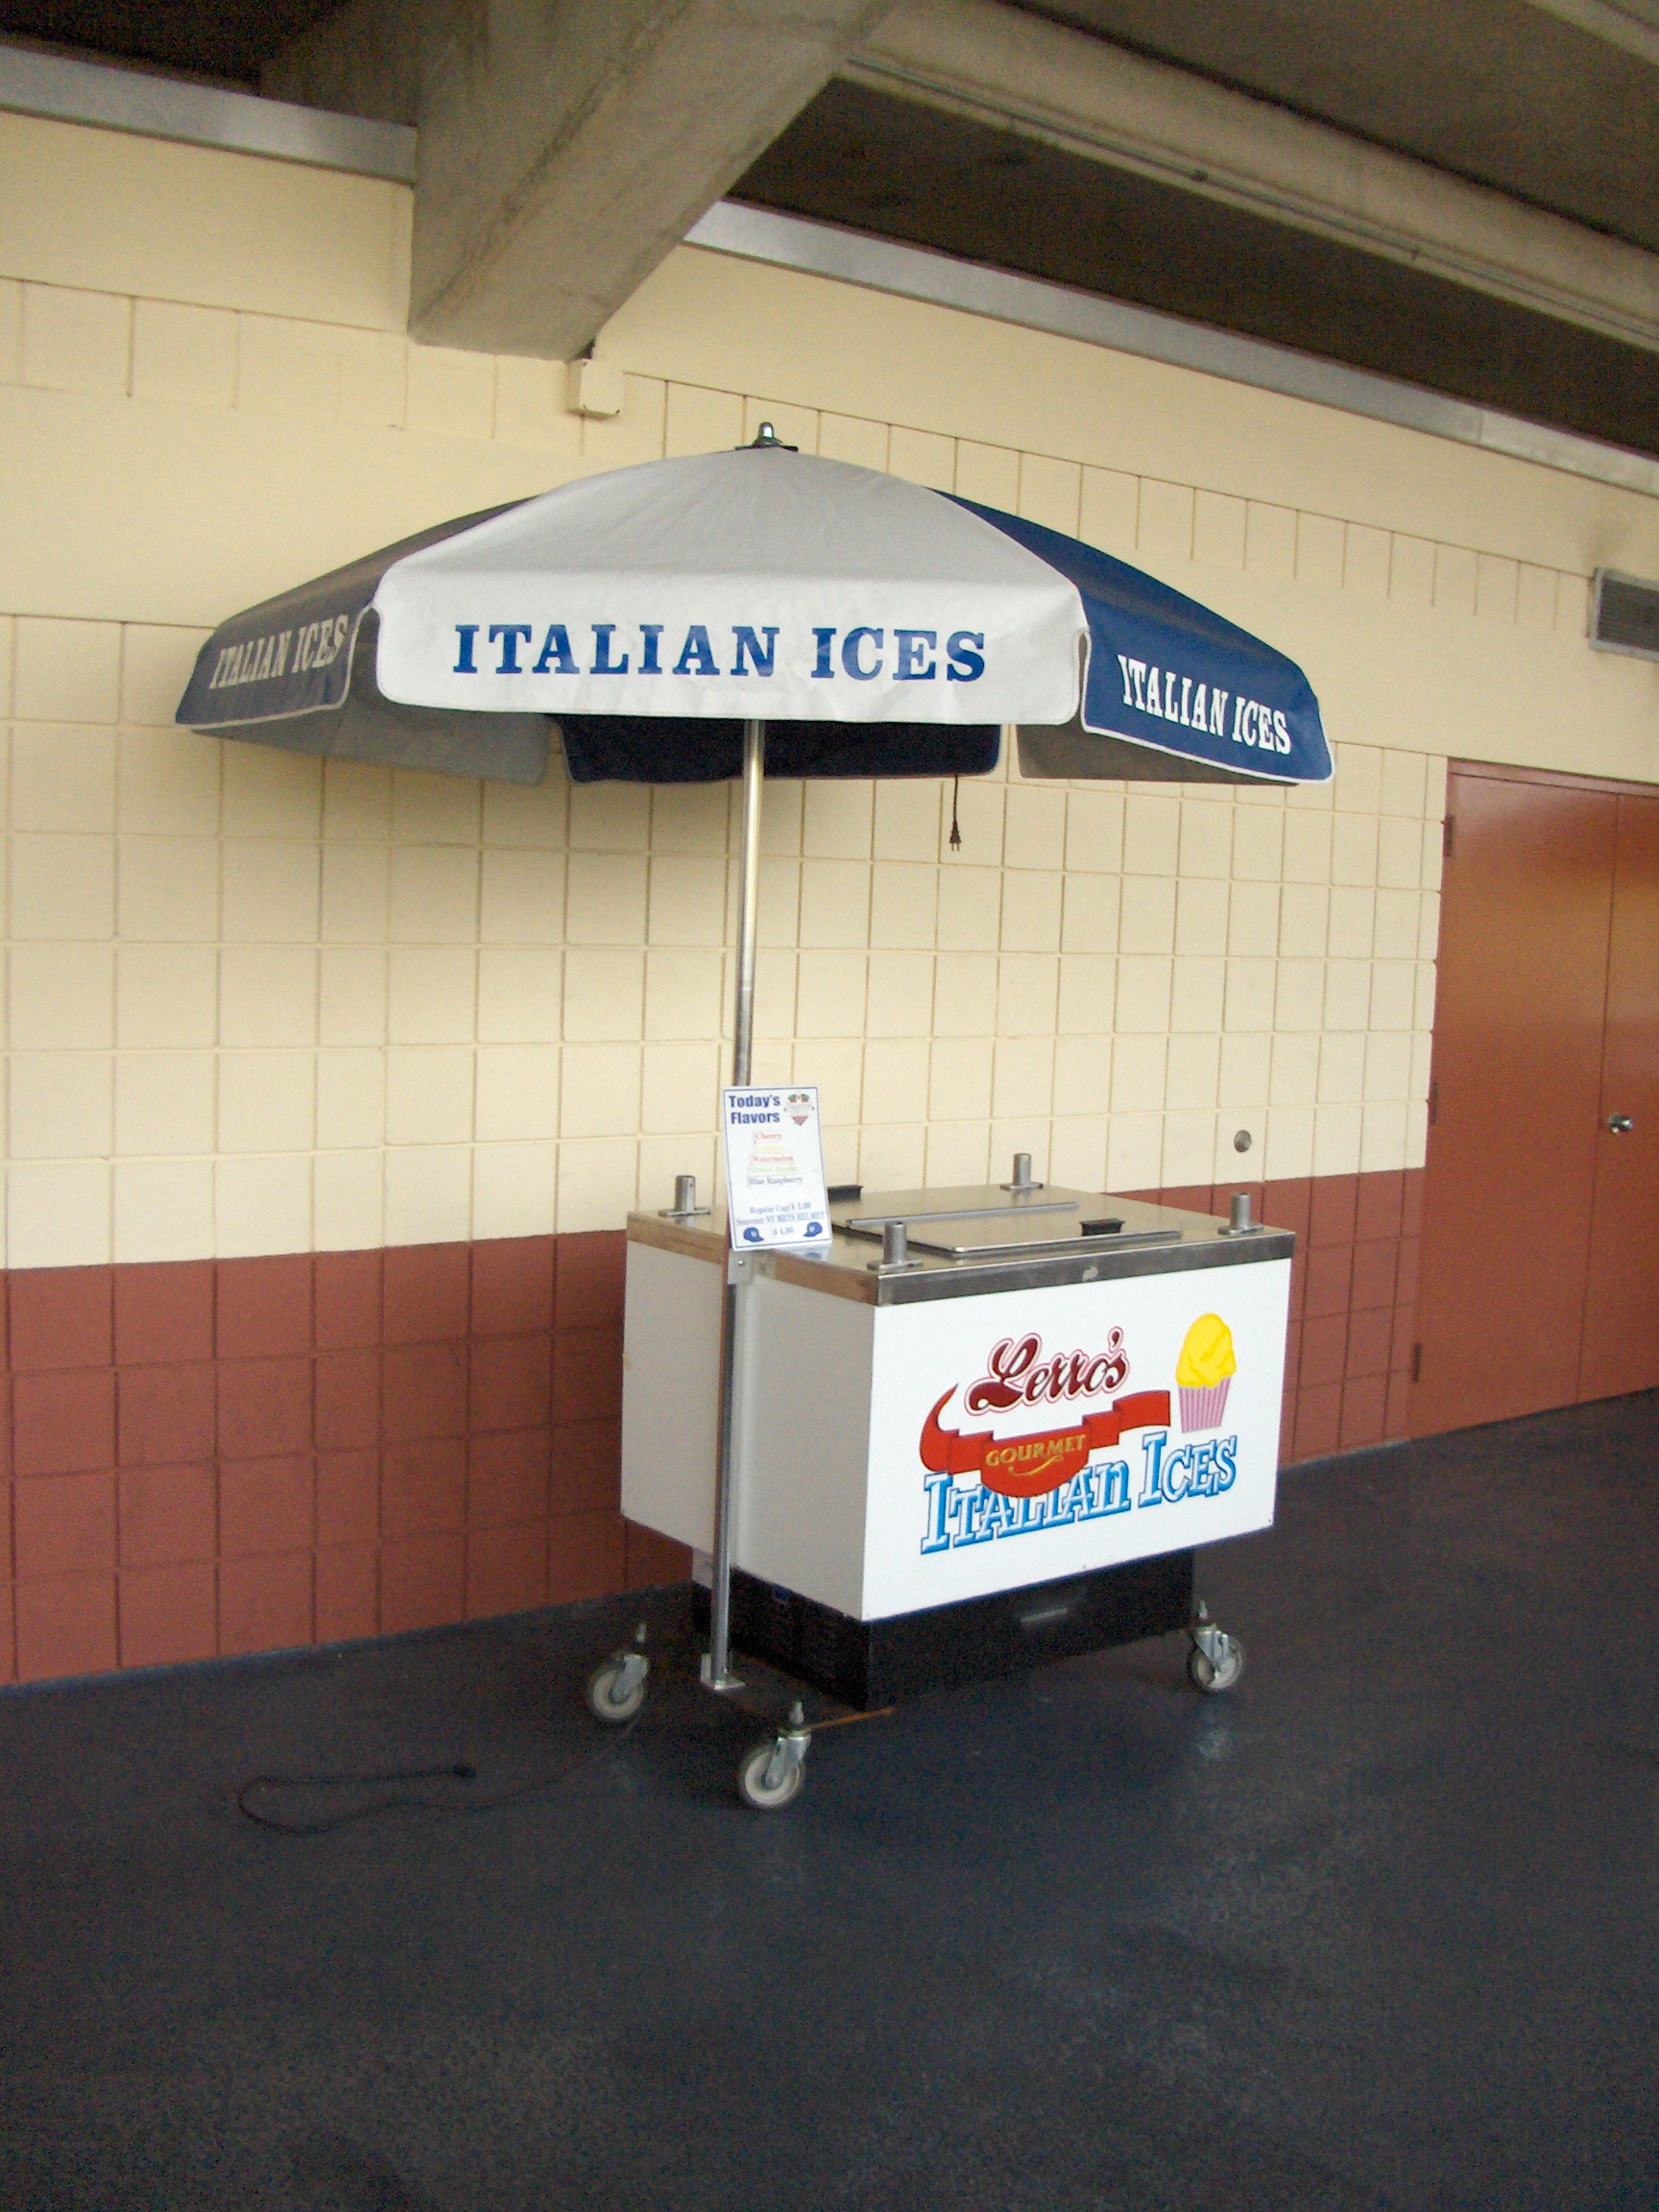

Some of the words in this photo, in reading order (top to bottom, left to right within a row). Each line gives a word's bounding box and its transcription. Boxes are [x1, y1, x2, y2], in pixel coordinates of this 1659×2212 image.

[209, 629, 288, 689] ITALIAN
[291, 613, 349, 674] ICES
[453, 623, 780, 678] ITALIAN
[810, 625, 986, 683] ICES
[1117, 653, 1230, 737] ITALIAN
[1232, 695, 1292, 756] ICES
[728, 1093, 781, 1109] Today's
[730, 1111, 781, 1125] Flavors
[755, 1131, 782, 1141] Cherry
[985, 1433, 1087, 1468] GOURMET
[1138, 1431, 1238, 1508] ICES
